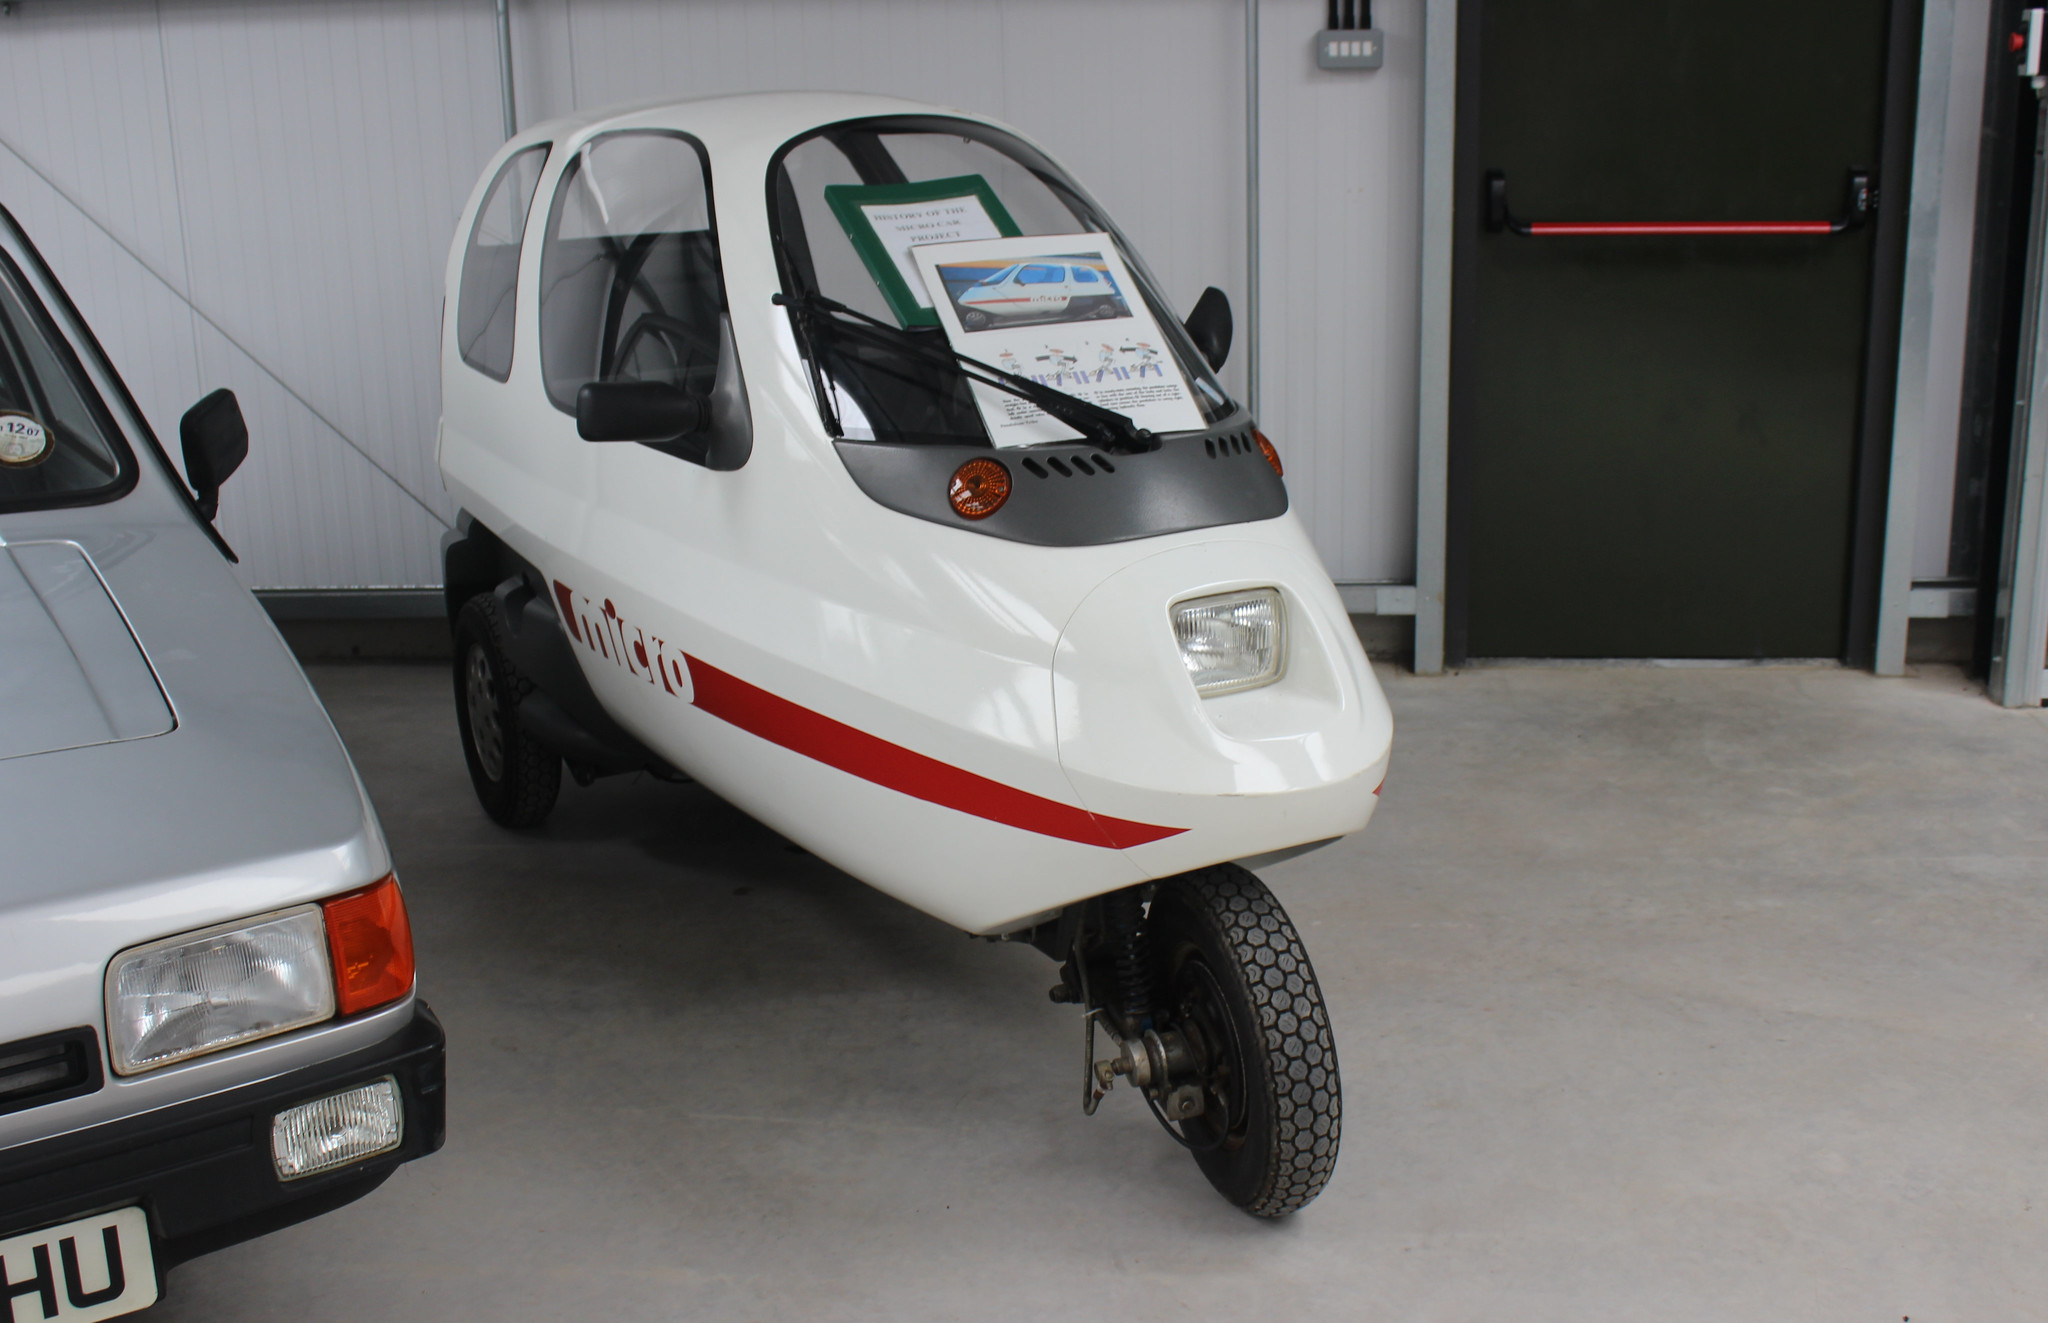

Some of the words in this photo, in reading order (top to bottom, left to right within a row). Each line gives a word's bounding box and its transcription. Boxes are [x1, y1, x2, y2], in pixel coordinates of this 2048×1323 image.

[926, 209, 941, 217] OF
[944, 206, 968, 215] THE
[7, 422, 25, 435] 12
[27, 428, 39, 436] 07
[569, 588, 695, 705] micro
[0, 1225, 126, 1323] HU
